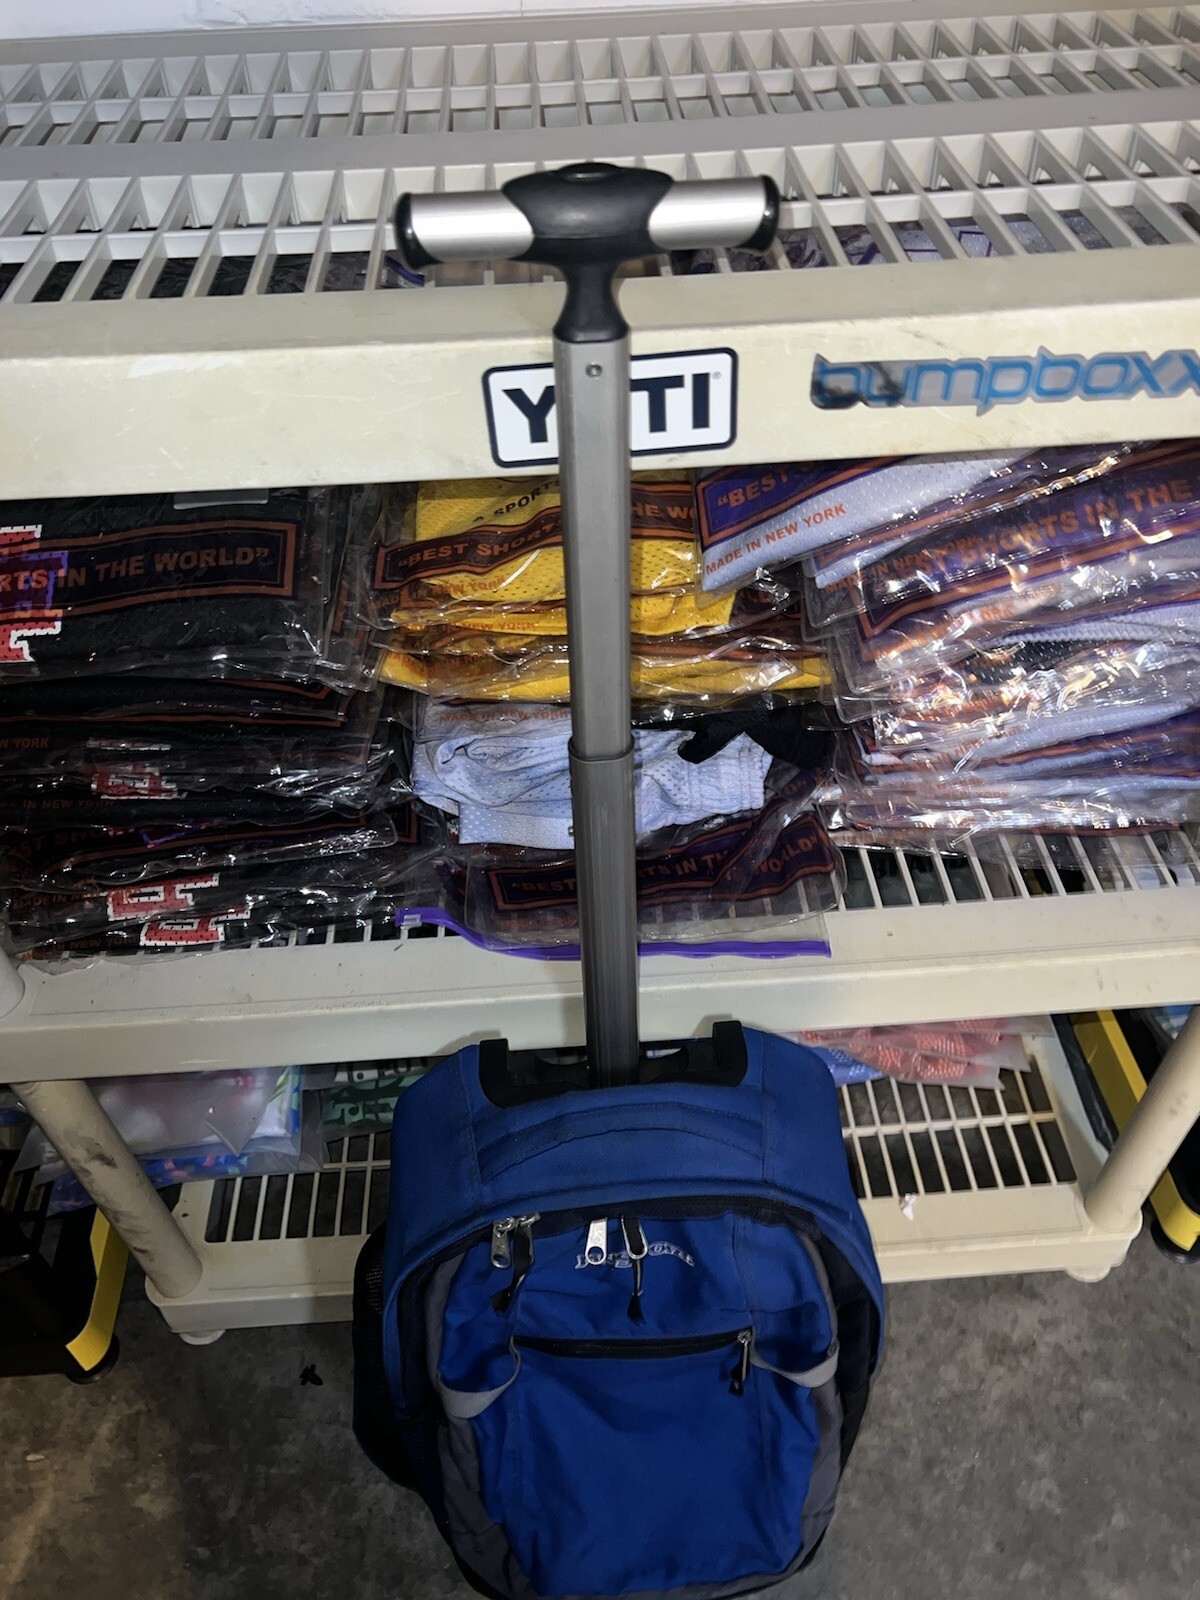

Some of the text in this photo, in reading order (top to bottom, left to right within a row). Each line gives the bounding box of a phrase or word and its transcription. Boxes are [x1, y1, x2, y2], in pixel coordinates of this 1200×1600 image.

[502, 372, 711, 444] YTI
[1083, 497, 1120, 527] IN
[1125, 479, 1194, 513] THE
[705, 503, 848, 576] MADE IN NEW YORK
[57, 565, 88, 589] IN
[95, 553, 146, 583] THE
[14, 736, 50, 749] YORK
[674, 857, 699, 877] IN
